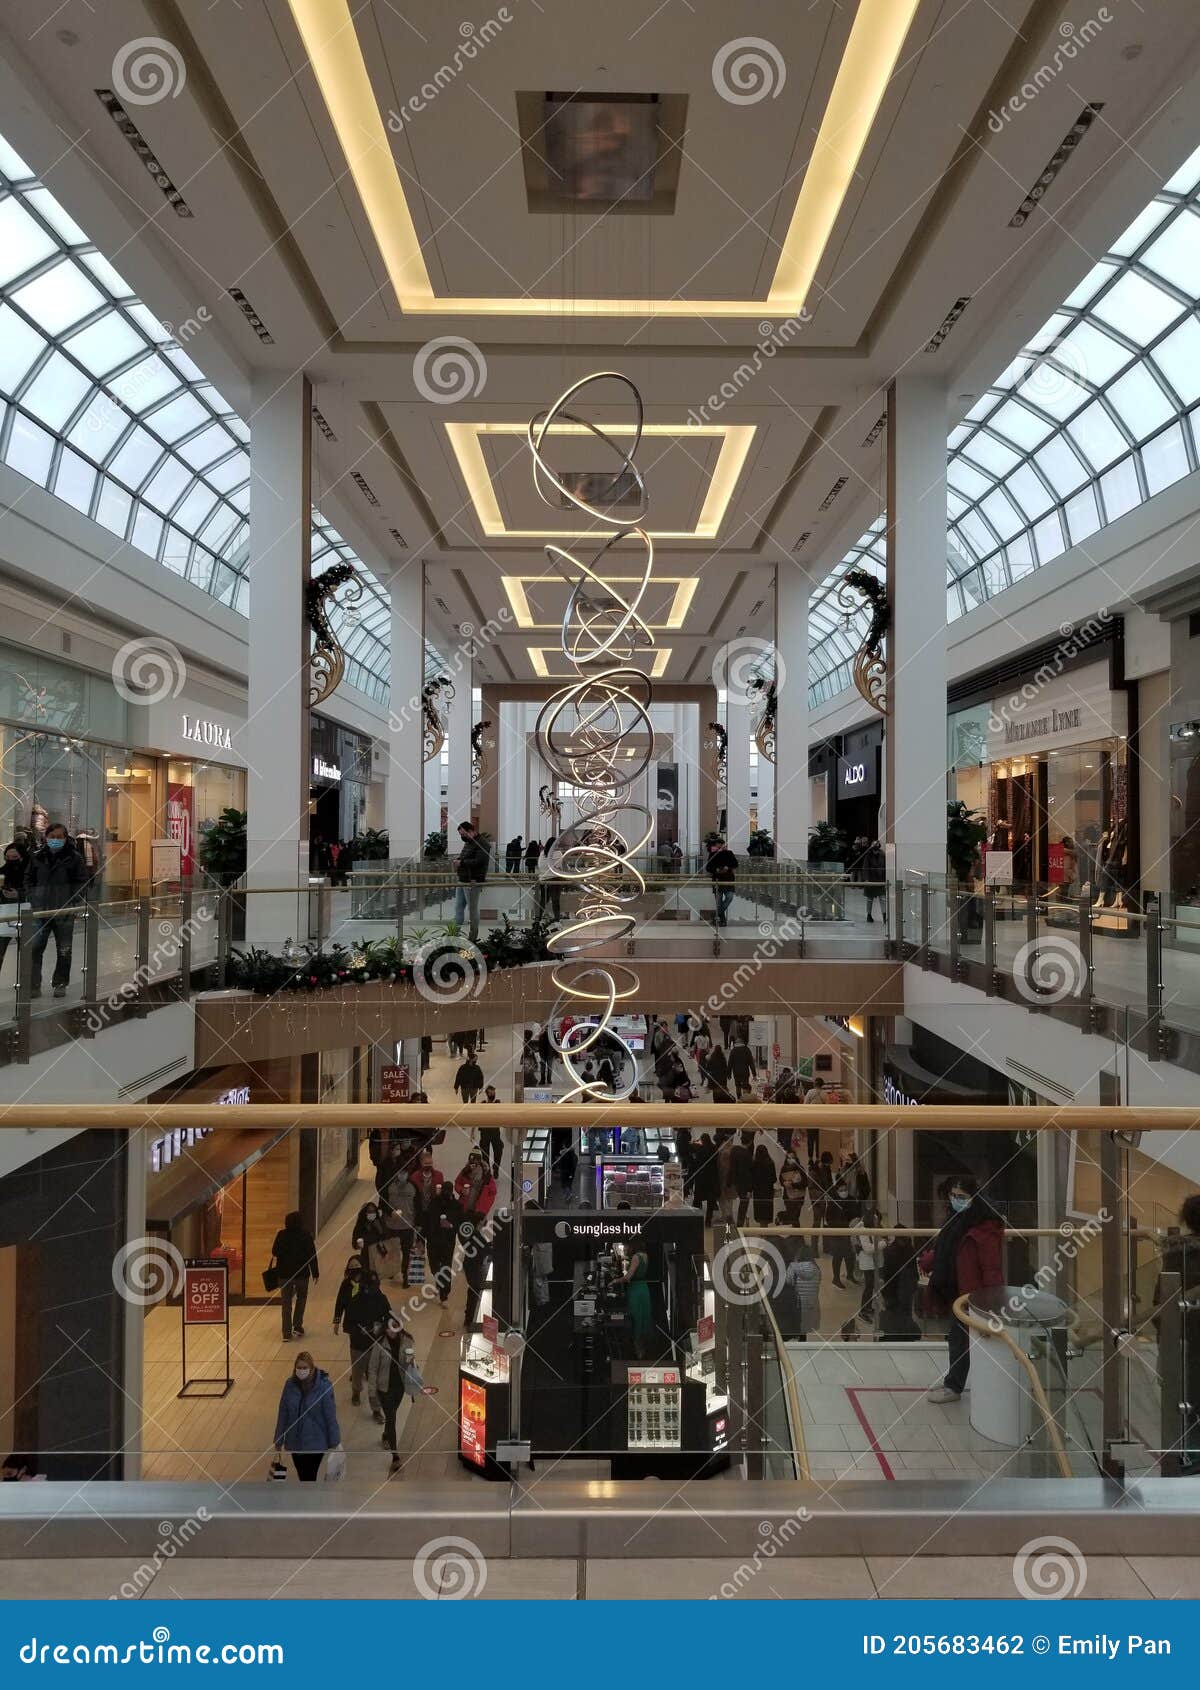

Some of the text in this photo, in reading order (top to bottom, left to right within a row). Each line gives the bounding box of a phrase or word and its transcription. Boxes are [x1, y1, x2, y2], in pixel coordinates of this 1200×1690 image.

[1052, 708, 1081, 733] LYNE
[182, 714, 233, 750] LAURA
[844, 763, 865, 785] ALDO
[1048, 857, 1064, 869] SALE
[383, 1070, 405, 1079] SALE
[573, 1222, 642, 1238] sunglass hut
[191, 1281, 220, 1293] 50%
[191, 1293, 220, 1305] OFF
